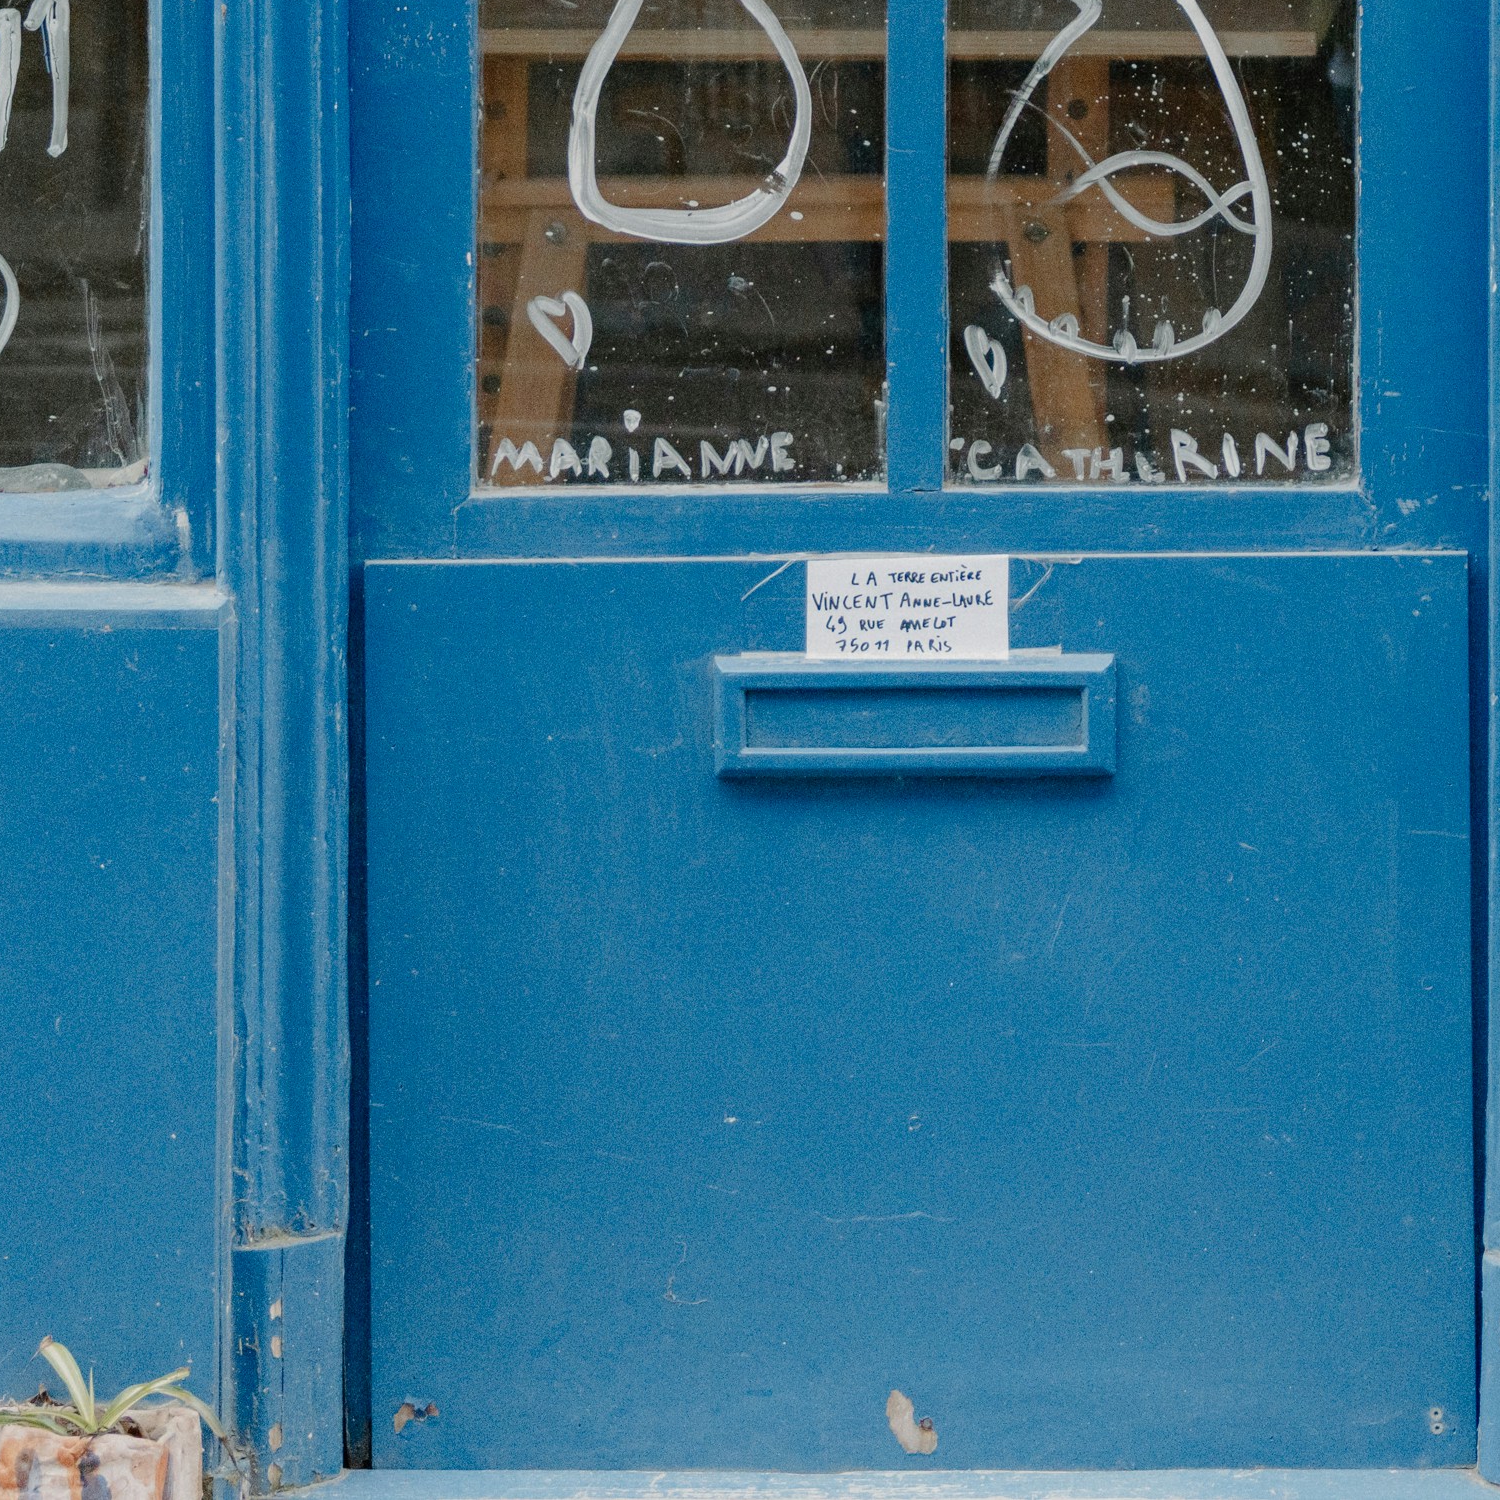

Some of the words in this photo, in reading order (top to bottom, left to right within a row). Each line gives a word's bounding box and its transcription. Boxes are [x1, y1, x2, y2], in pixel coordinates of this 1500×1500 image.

[491, 410, 796, 482] MARIANNE
[851, 571, 877, 586] LA
[888, 571, 926, 584] TERRE
[812, 592, 893, 611] VINCENT
[826, 615, 847, 634] 49
[859, 619, 886, 632] RUE
[900, 616, 956, 632] AMELOT
[836, 637, 890, 652] 75011
[906, 635, 953, 652] PARIS
